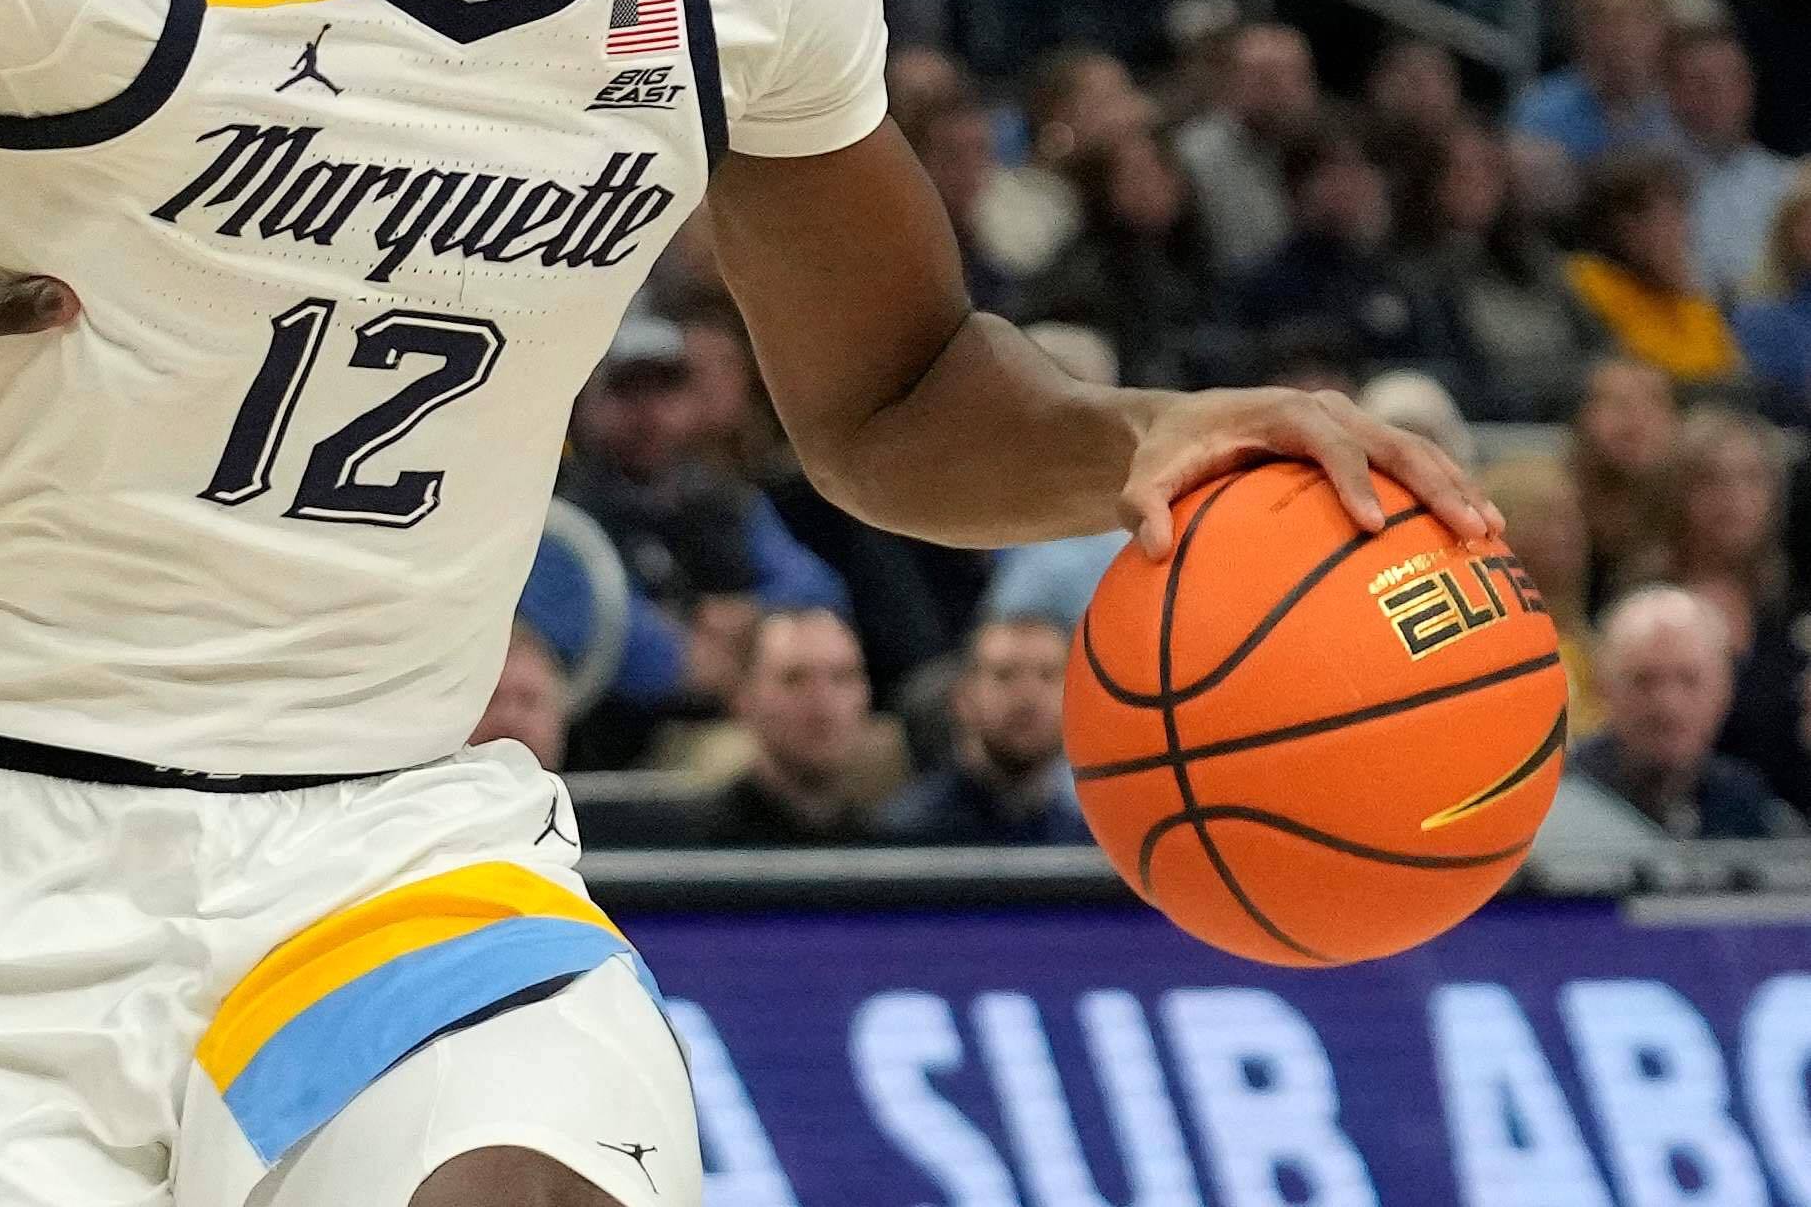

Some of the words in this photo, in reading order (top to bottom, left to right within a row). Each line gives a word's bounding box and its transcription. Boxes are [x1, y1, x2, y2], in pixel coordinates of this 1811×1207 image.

[594, 85, 687, 103] EAST
[609, 64, 675, 86] BIG
[150, 123, 676, 283] Marquette
[196, 296, 508, 530] 12
[849, 985, 1383, 1207] SUB
